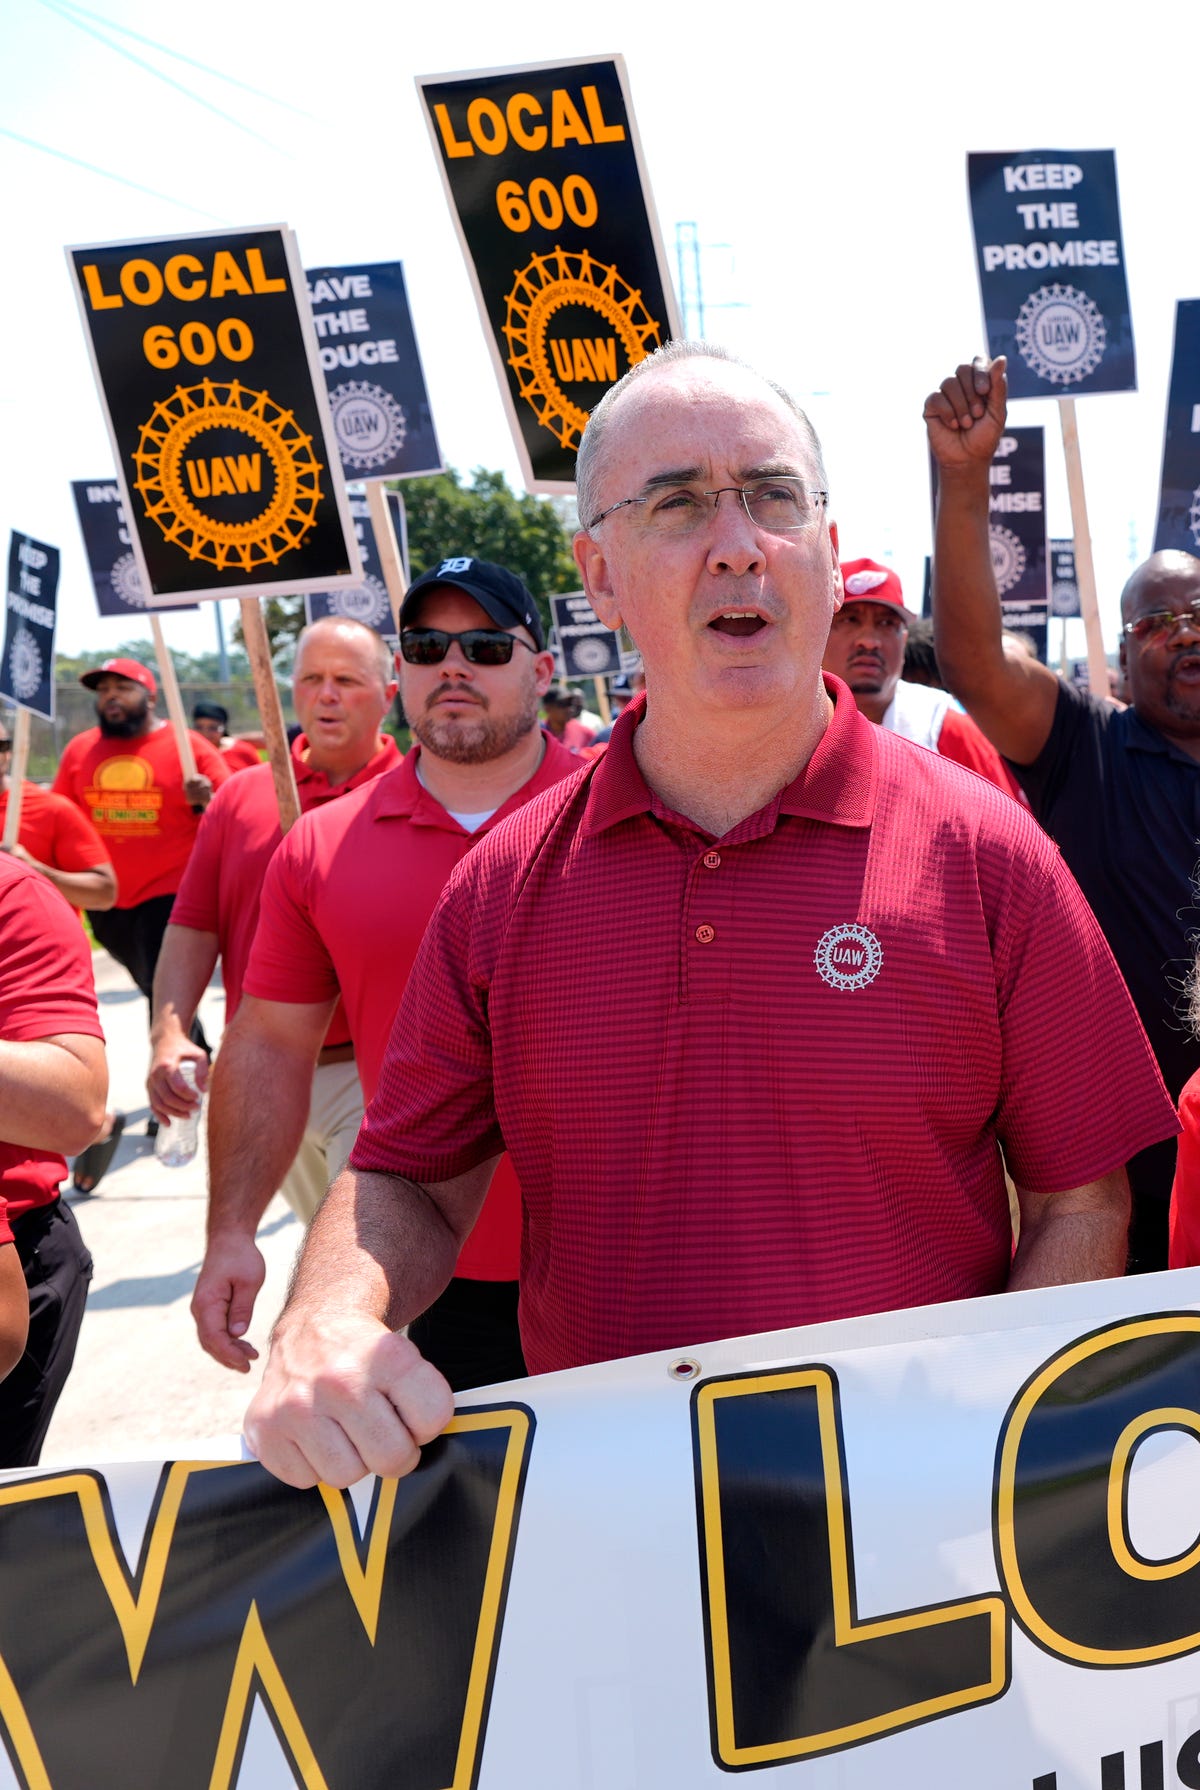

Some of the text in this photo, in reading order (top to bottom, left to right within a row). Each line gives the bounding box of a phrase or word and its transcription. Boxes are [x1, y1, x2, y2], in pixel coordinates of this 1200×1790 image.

[434, 86, 625, 158] LOCAL
[1003, 164, 1083, 192] KEEP
[496, 175, 598, 233] 600
[1016, 203, 1079, 230] THE
[983, 240, 1119, 271] PROMISE
[83, 248, 286, 310] LOCAL
[313, 308, 370, 337] THE
[1042, 323, 1080, 346] UAW
[143, 318, 254, 369] 600
[320, 339, 400, 371] OUGE
[550, 338, 617, 382] UAW
[342, 413, 379, 436] UAW
[186, 453, 261, 498] UAW
[20, 571, 41, 597] THE
[7, 591, 55, 630] PROMISE
[833, 947, 865, 967] UAW
